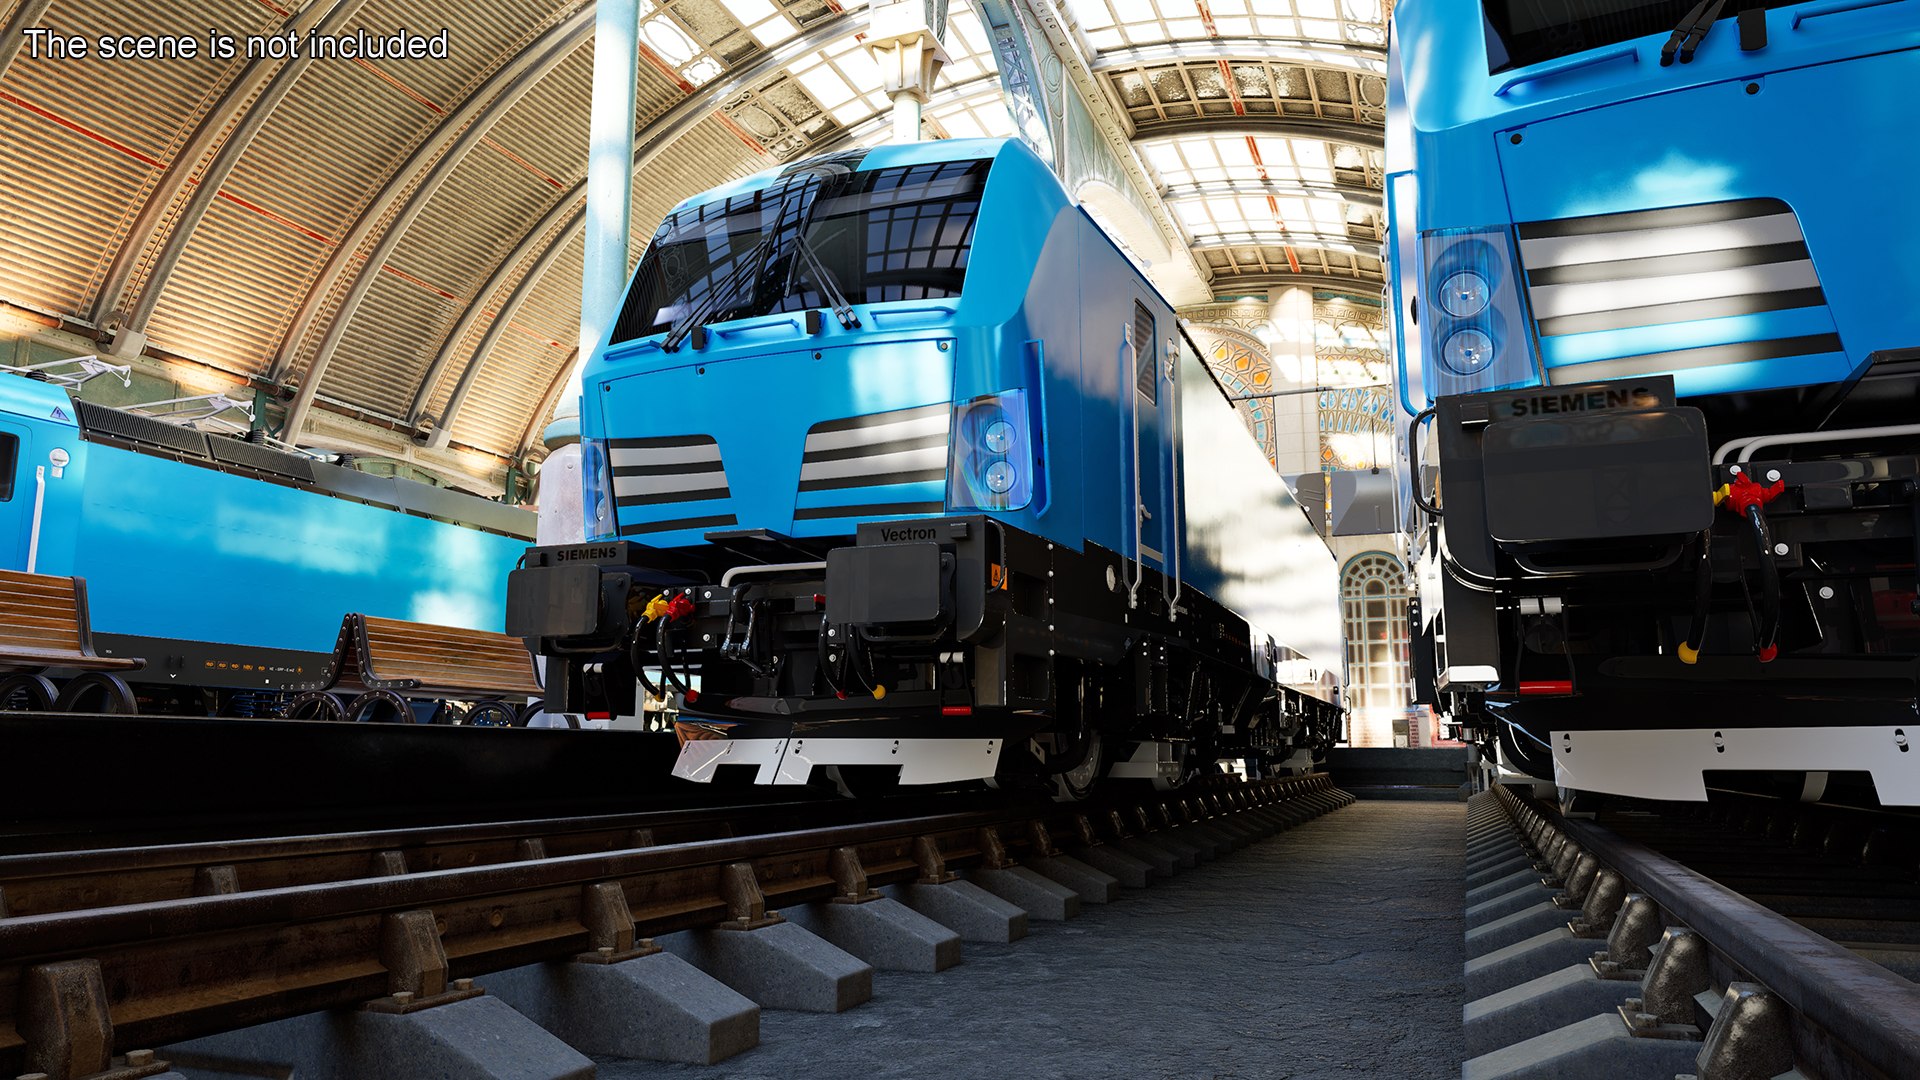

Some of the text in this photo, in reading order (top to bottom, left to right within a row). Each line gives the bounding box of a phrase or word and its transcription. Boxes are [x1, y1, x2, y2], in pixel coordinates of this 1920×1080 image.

[1511, 387, 1652, 417] SIEMENS
[881, 528, 937, 542] Vectron
[557, 547, 617, 562] SIEMENS
